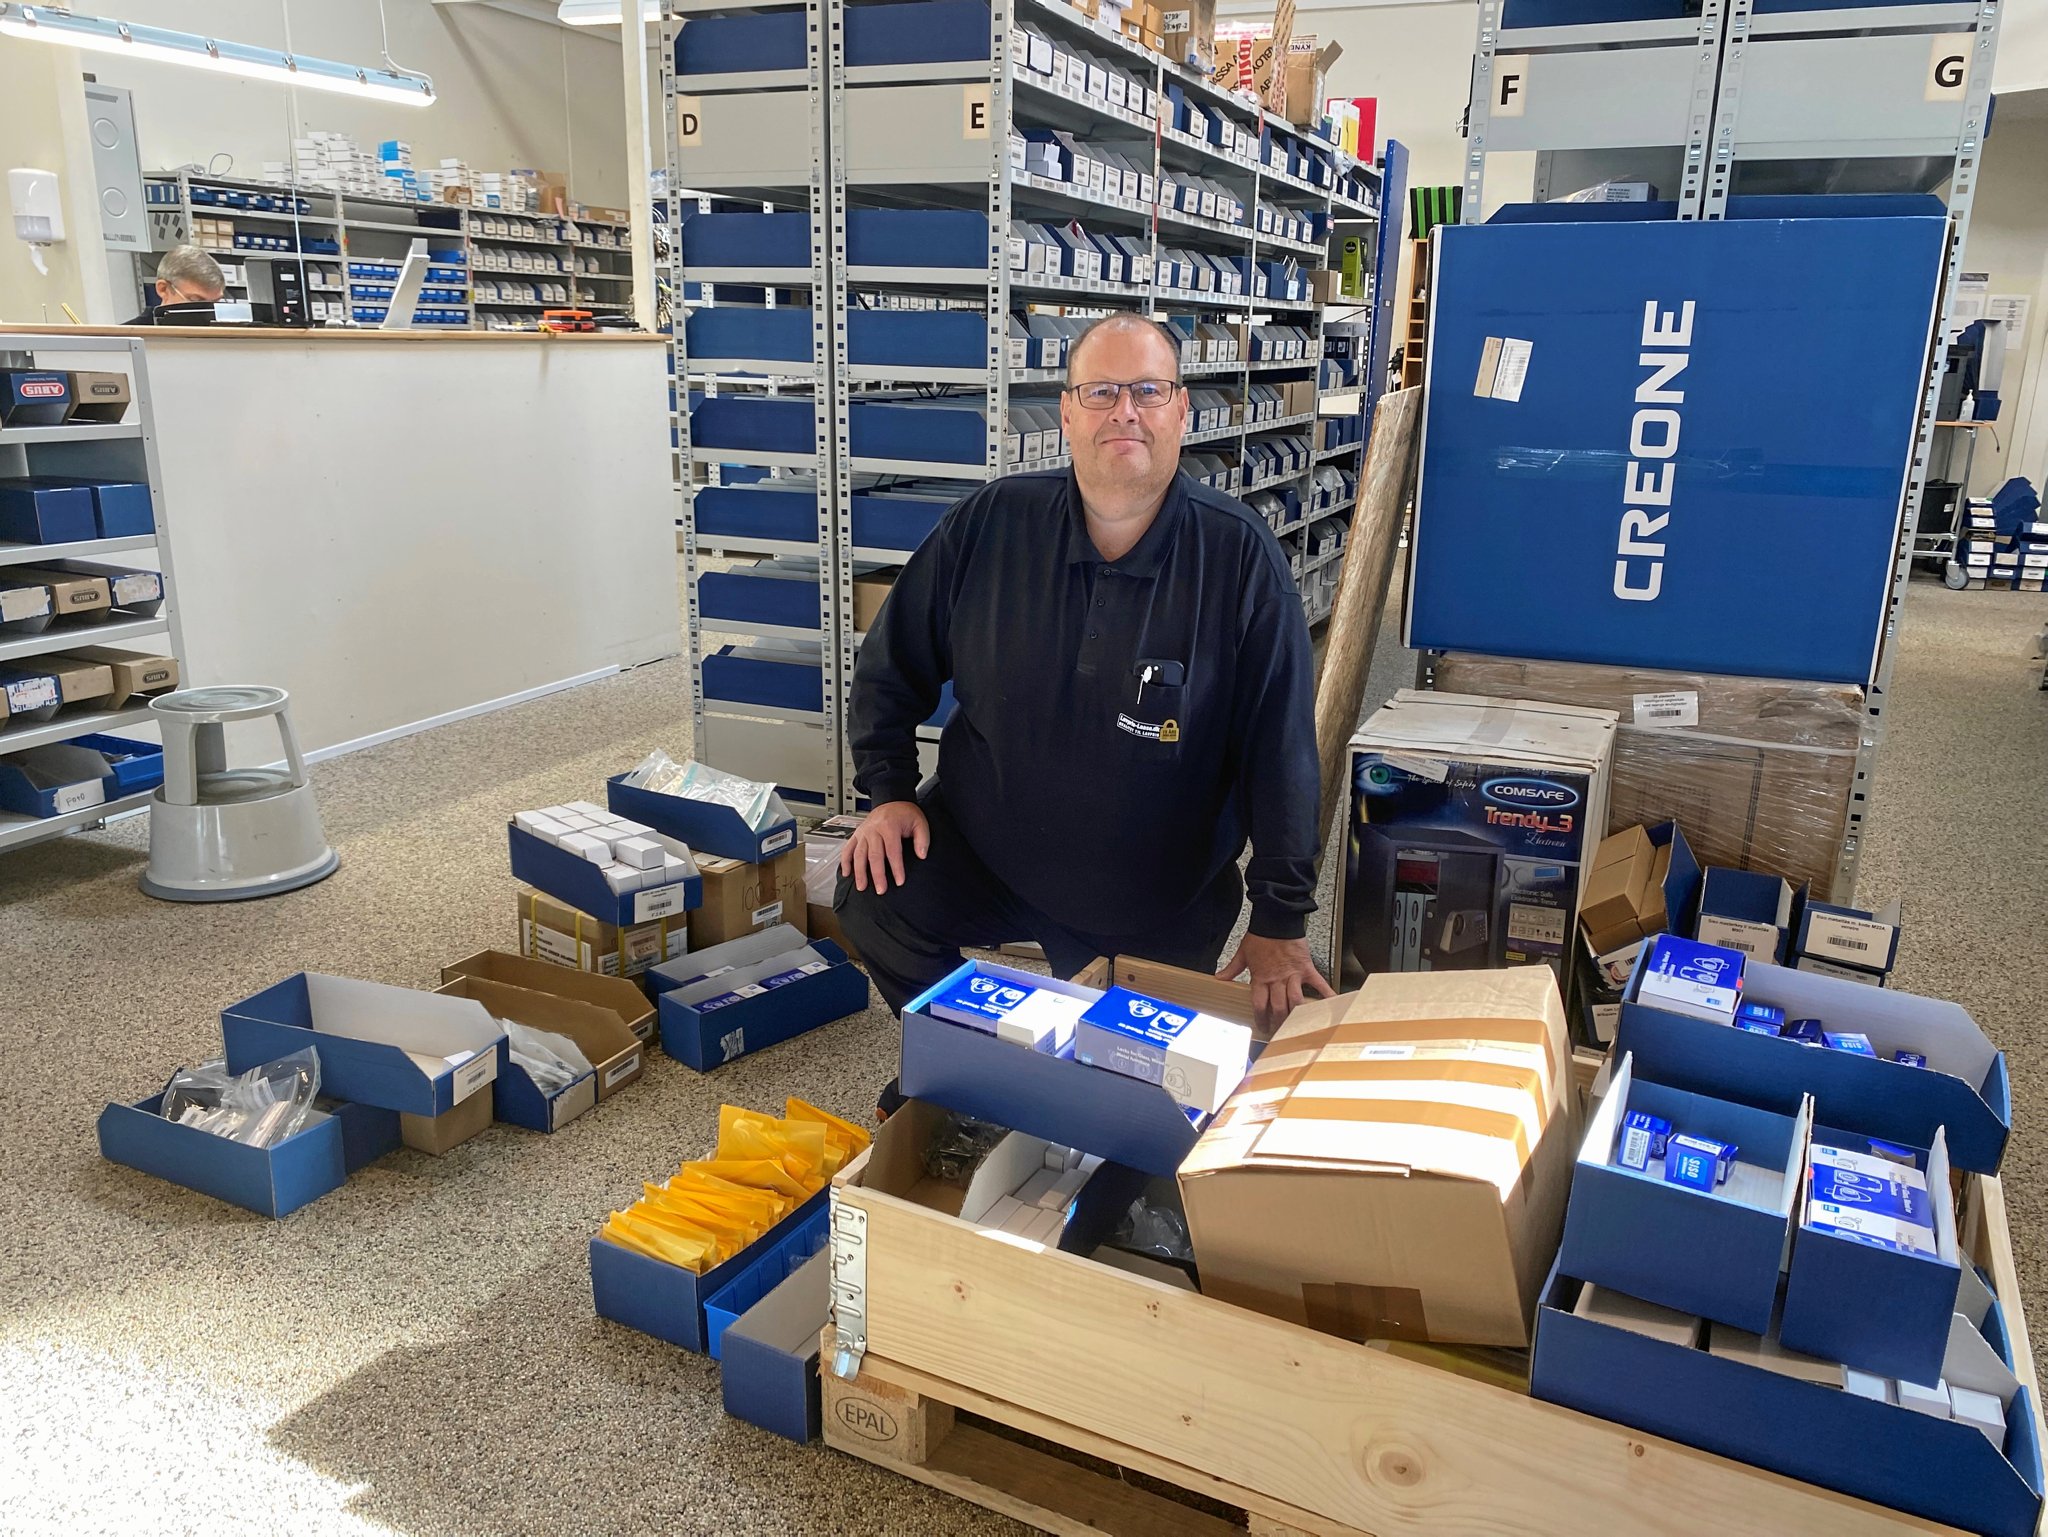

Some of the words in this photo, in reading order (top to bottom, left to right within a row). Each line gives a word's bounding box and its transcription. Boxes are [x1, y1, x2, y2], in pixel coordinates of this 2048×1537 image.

[1935, 55, 1965, 88] G
[1501, 75, 1520, 106] F
[682, 113, 699, 136] D
[970, 103, 985, 130] E
[27, 386, 60, 395] ABUS
[1614, 301, 1695, 600] CREONE
[73, 593, 97, 603] ABUS
[145, 672, 167, 682] ABUS
[1494, 785, 1565, 801] COMSAFE
[1525, 832, 1568, 848] Electronic
[1687, 1157, 1702, 1178] SISO
[845, 1404, 890, 1436] EPAL
